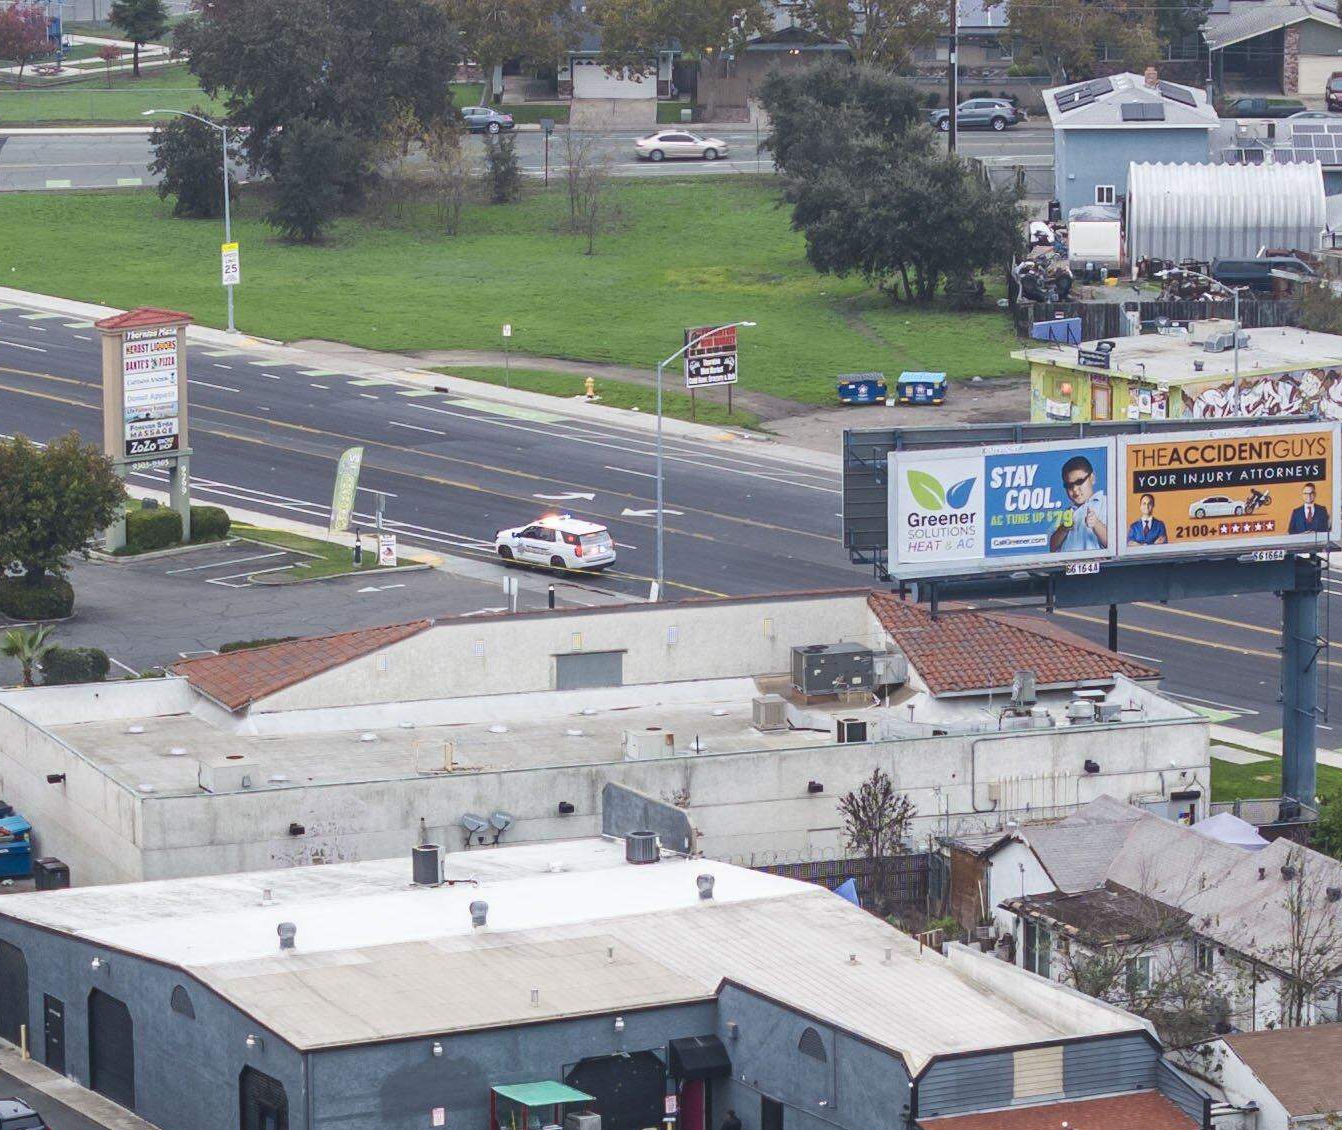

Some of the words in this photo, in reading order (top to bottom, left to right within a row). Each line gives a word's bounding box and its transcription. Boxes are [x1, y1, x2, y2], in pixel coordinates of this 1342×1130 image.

[224, 264, 237, 273] 25
[150, 340, 176, 352] LIQUORS
[125, 359, 149, 371] DANTE'S
[158, 356, 175, 367] PIZZA
[990, 464, 1038, 488] STAY
[1138, 475, 1177, 487] YOUR
[1183, 471, 1233, 484] INJURY
[1240, 464, 1319, 480] ATTORNEYS
[1005, 488, 1062, 511] COOL.
[908, 511, 976, 528] Greener
[990, 514, 1004, 526] AC
[1006, 513, 1030, 525] TUNE
[1032, 512, 1045, 524] UP
[908, 525, 976, 540] SOLUTIONS
[1175, 524, 1218, 538] 2100+
[908, 540, 942, 552] HEAT
[946, 541, 953, 550] &
[956, 538, 974, 549] AC
